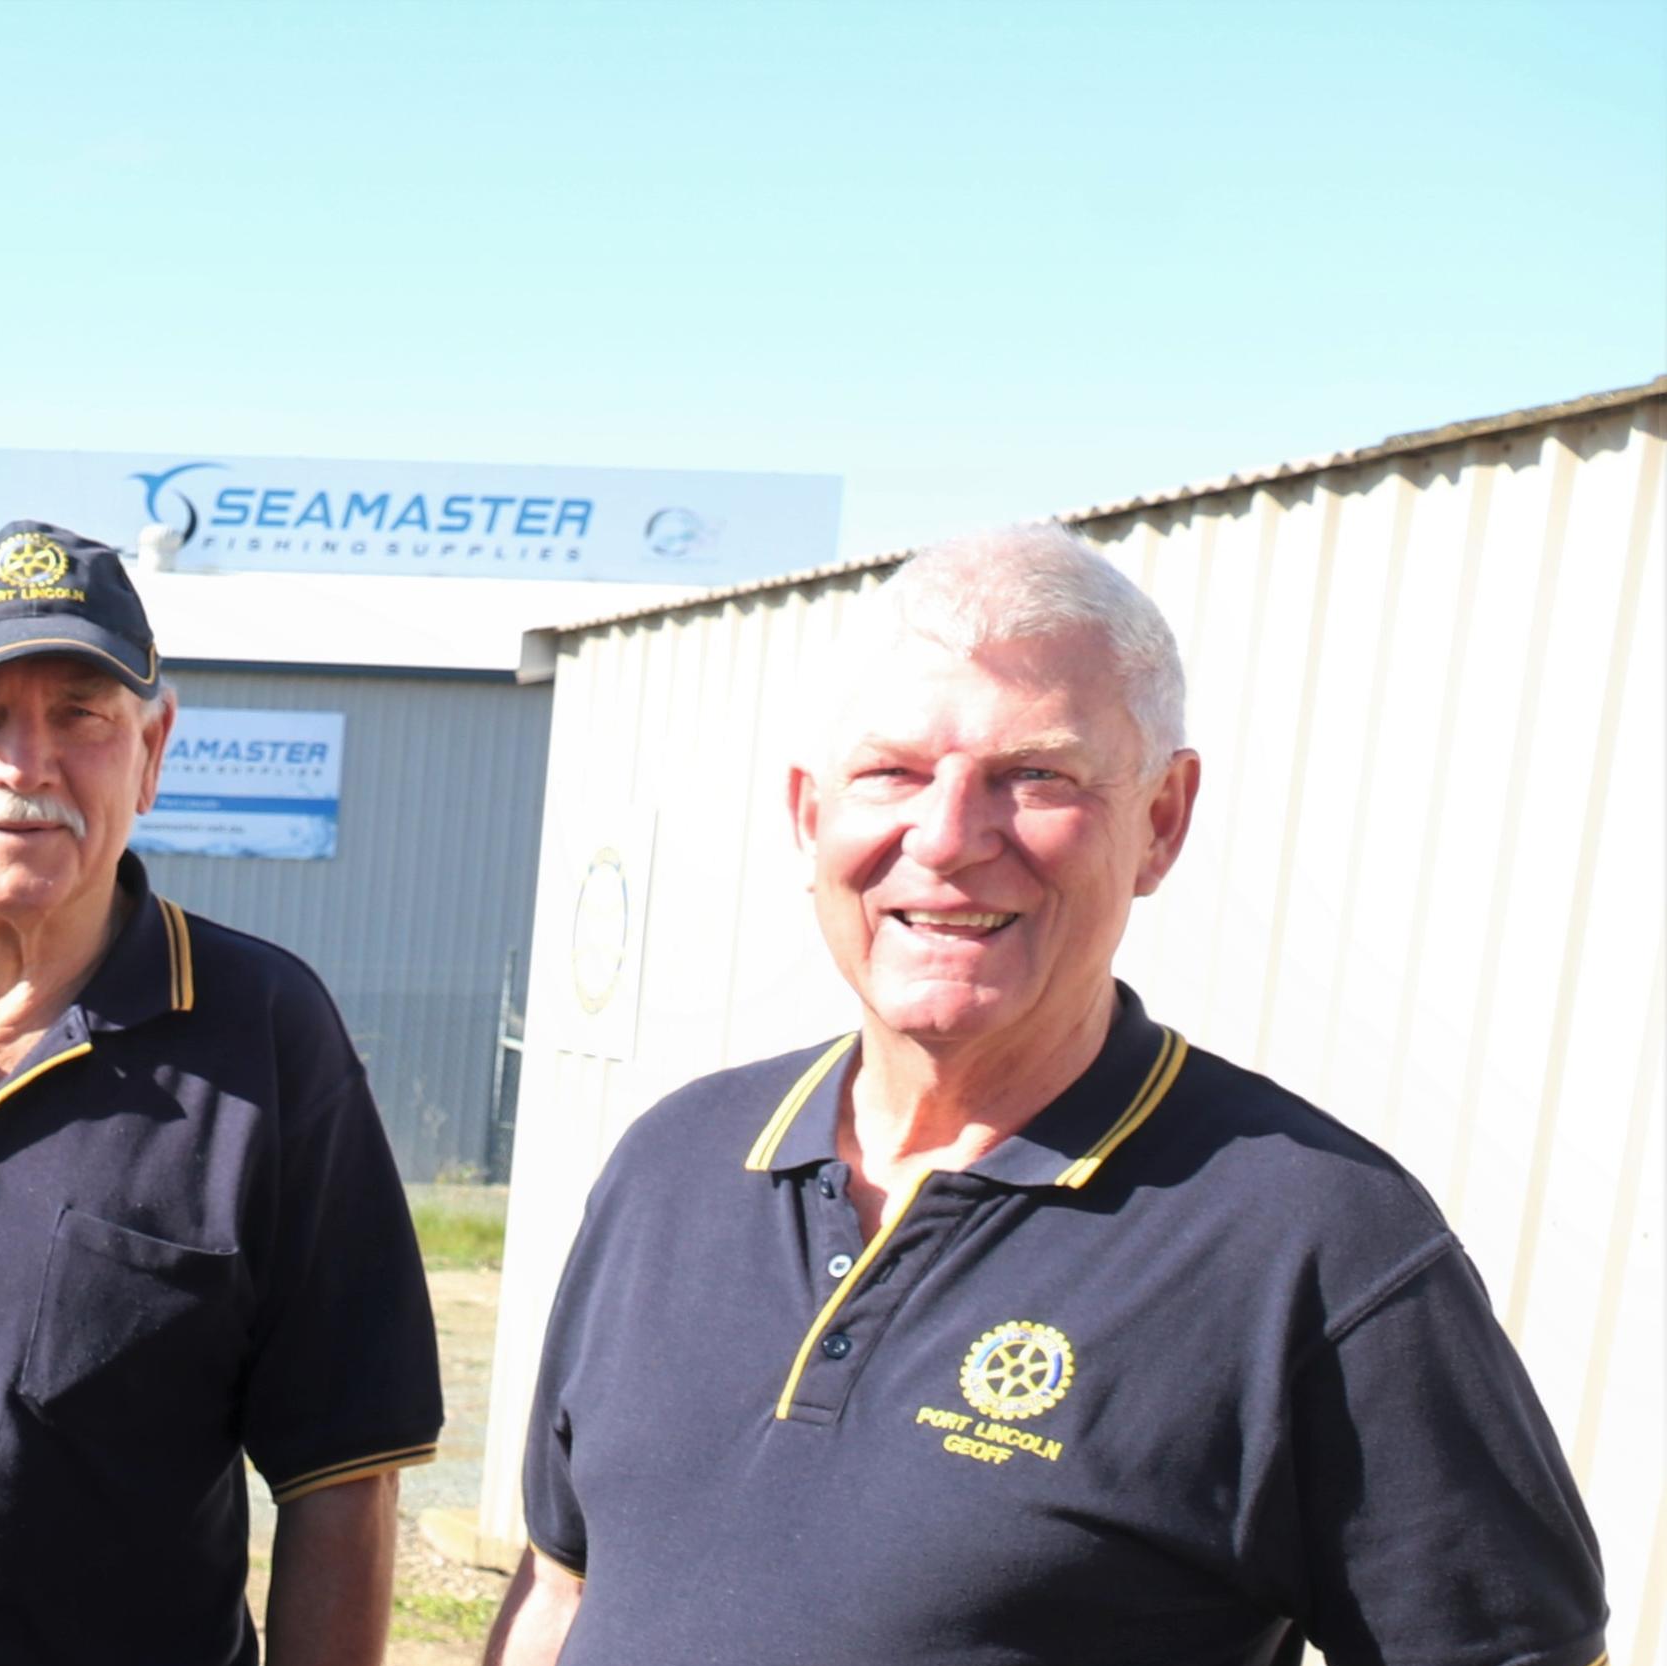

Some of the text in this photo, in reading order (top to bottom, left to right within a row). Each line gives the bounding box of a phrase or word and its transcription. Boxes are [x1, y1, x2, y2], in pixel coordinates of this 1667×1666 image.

[210, 488, 594, 537] SEAMASTER
[202, 536, 582, 562] FISHING SUPPLIES
[20, 587, 86, 603] LINCOLN
[168, 738, 329, 765] AMASTER
[916, 1407, 1063, 1461] PORT LINCOLN
[943, 1434, 1013, 1464] GEOFF
